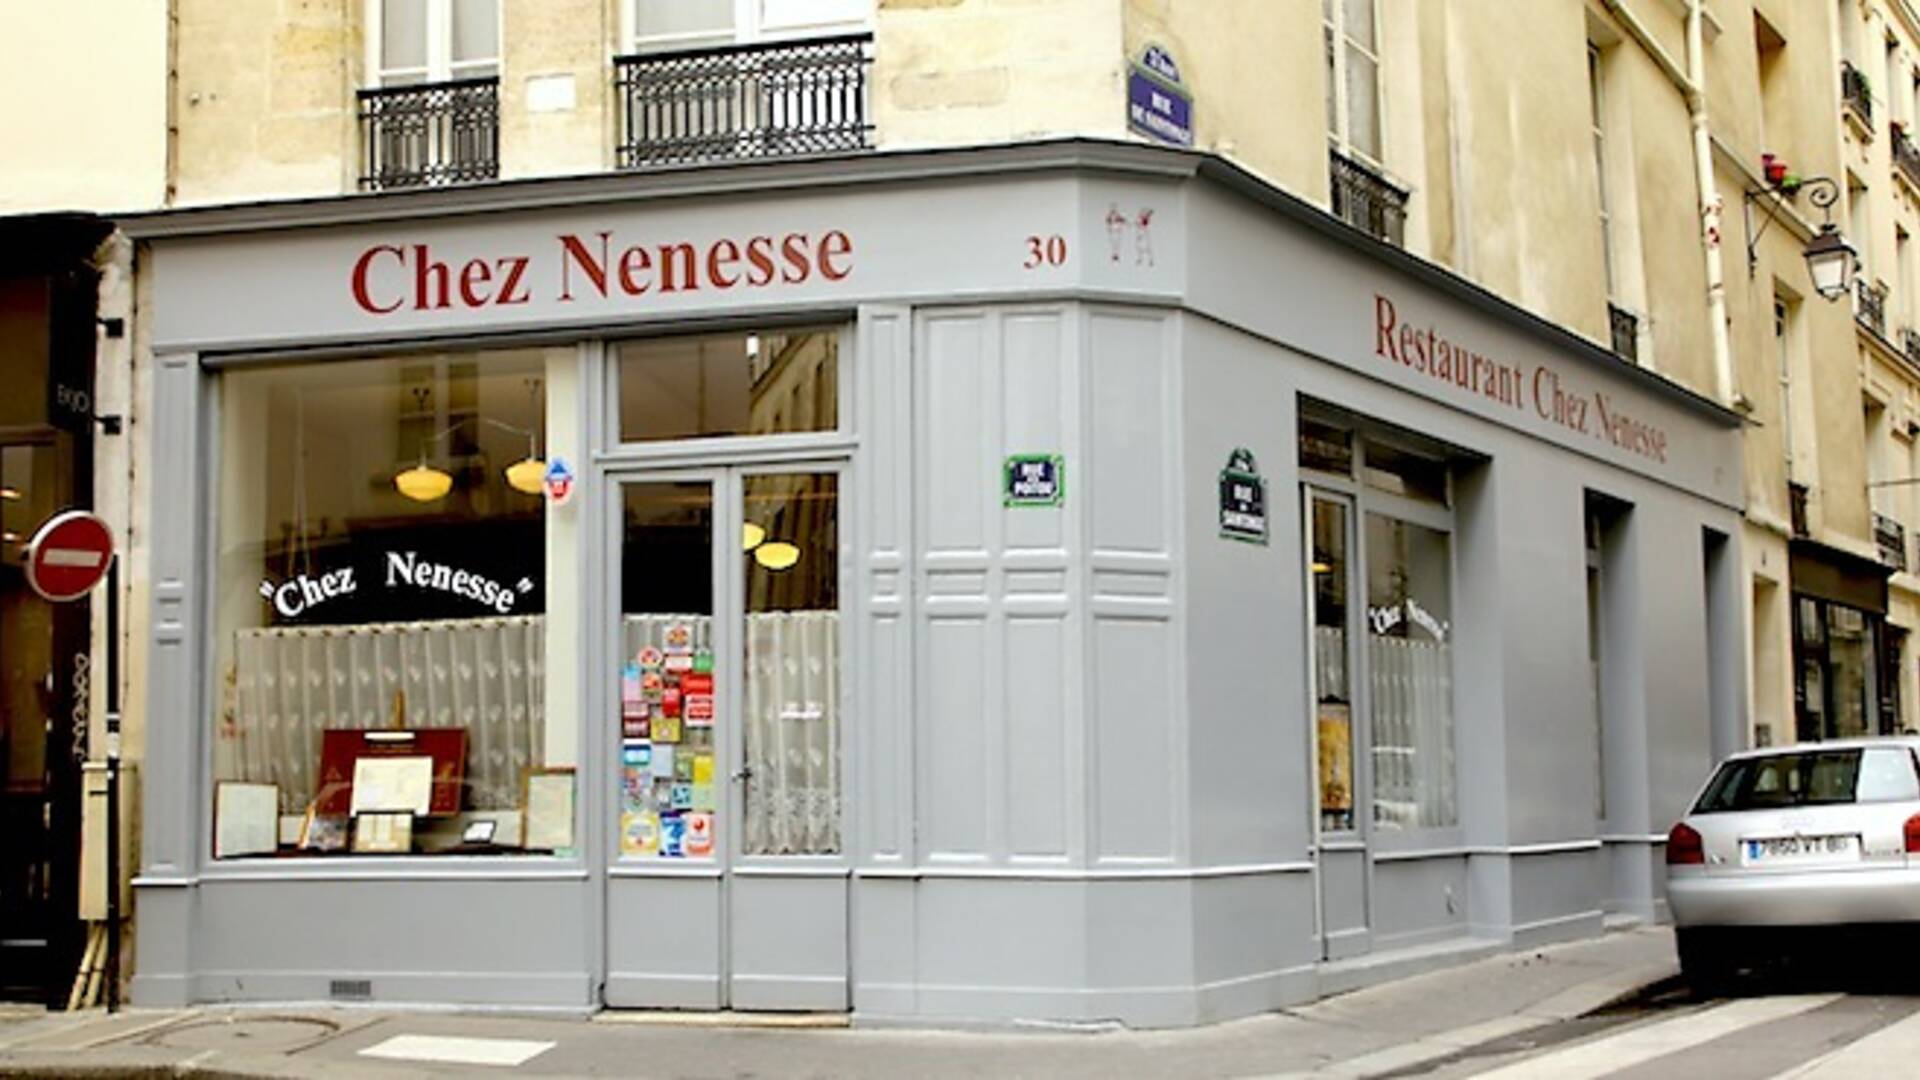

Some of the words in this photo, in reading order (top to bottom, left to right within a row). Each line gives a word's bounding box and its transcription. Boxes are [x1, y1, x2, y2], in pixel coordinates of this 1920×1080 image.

[350, 244, 529, 315] Chez
[556, 229, 852, 303] Nenesse
[1023, 236, 1067, 270] 30
[1374, 295, 1523, 409] Restaurant
[1532, 365, 1589, 436] Chez
